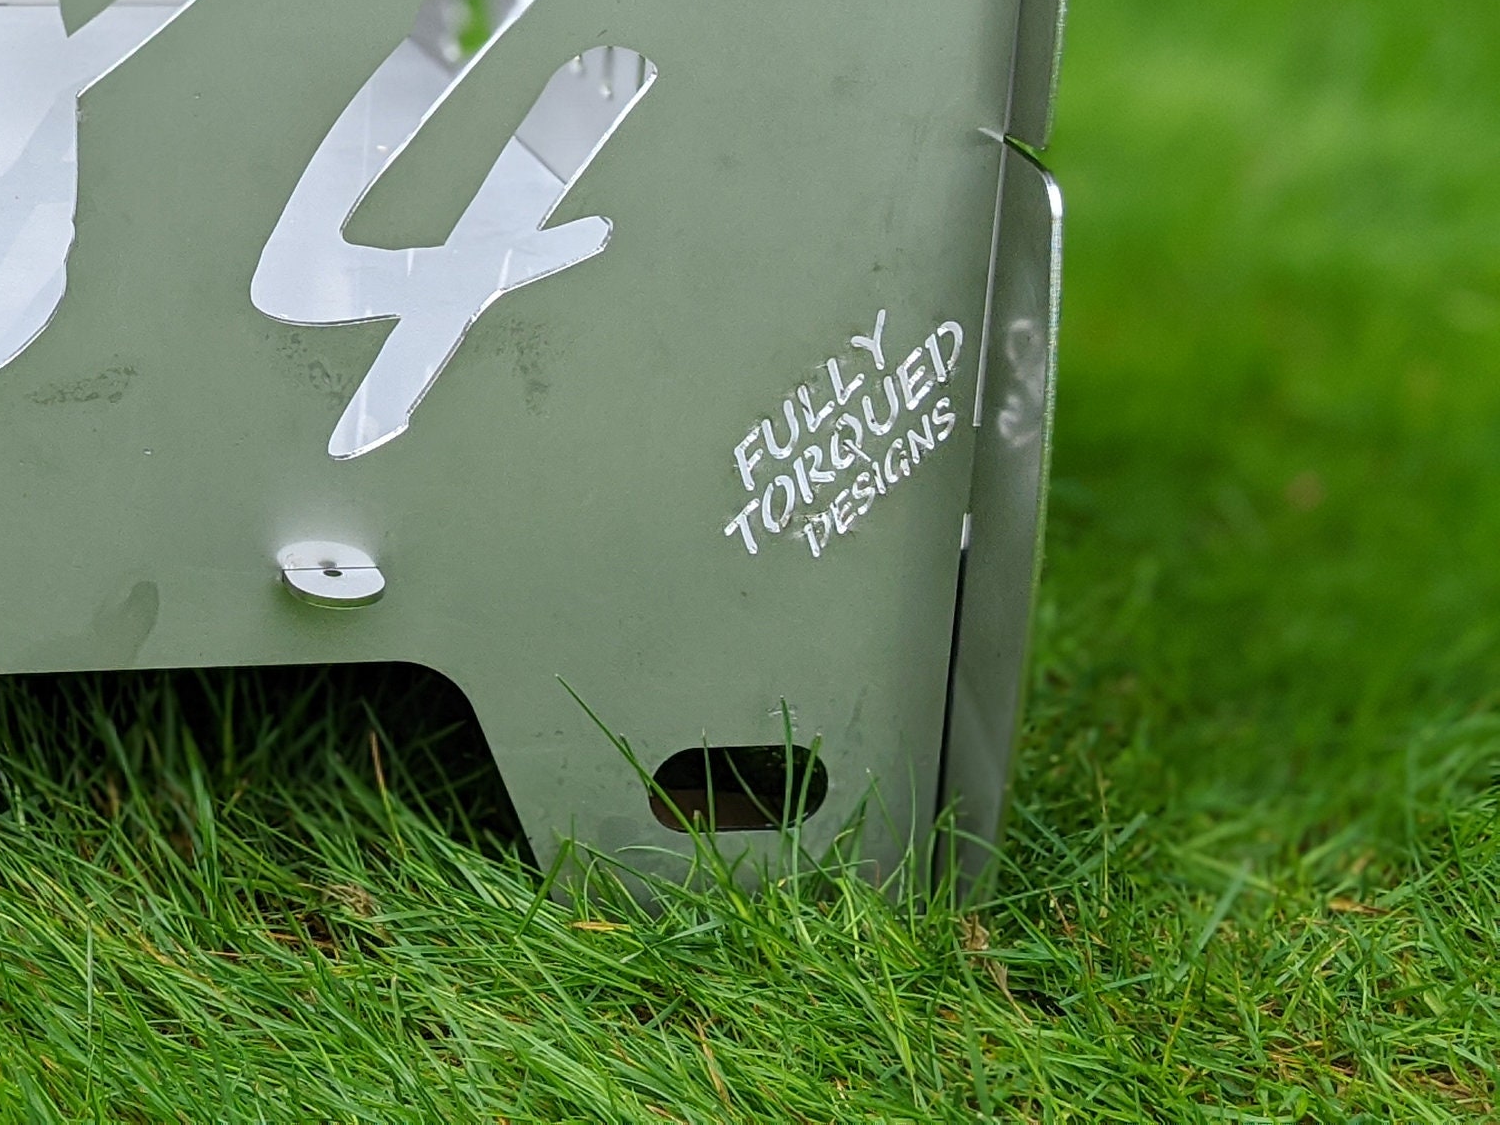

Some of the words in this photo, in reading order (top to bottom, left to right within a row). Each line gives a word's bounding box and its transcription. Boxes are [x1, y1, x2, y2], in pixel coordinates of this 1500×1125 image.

[723, 320, 963, 555] TORQUED
[733, 309, 886, 491] FULLY
[804, 397, 956, 557] DESIGNS
